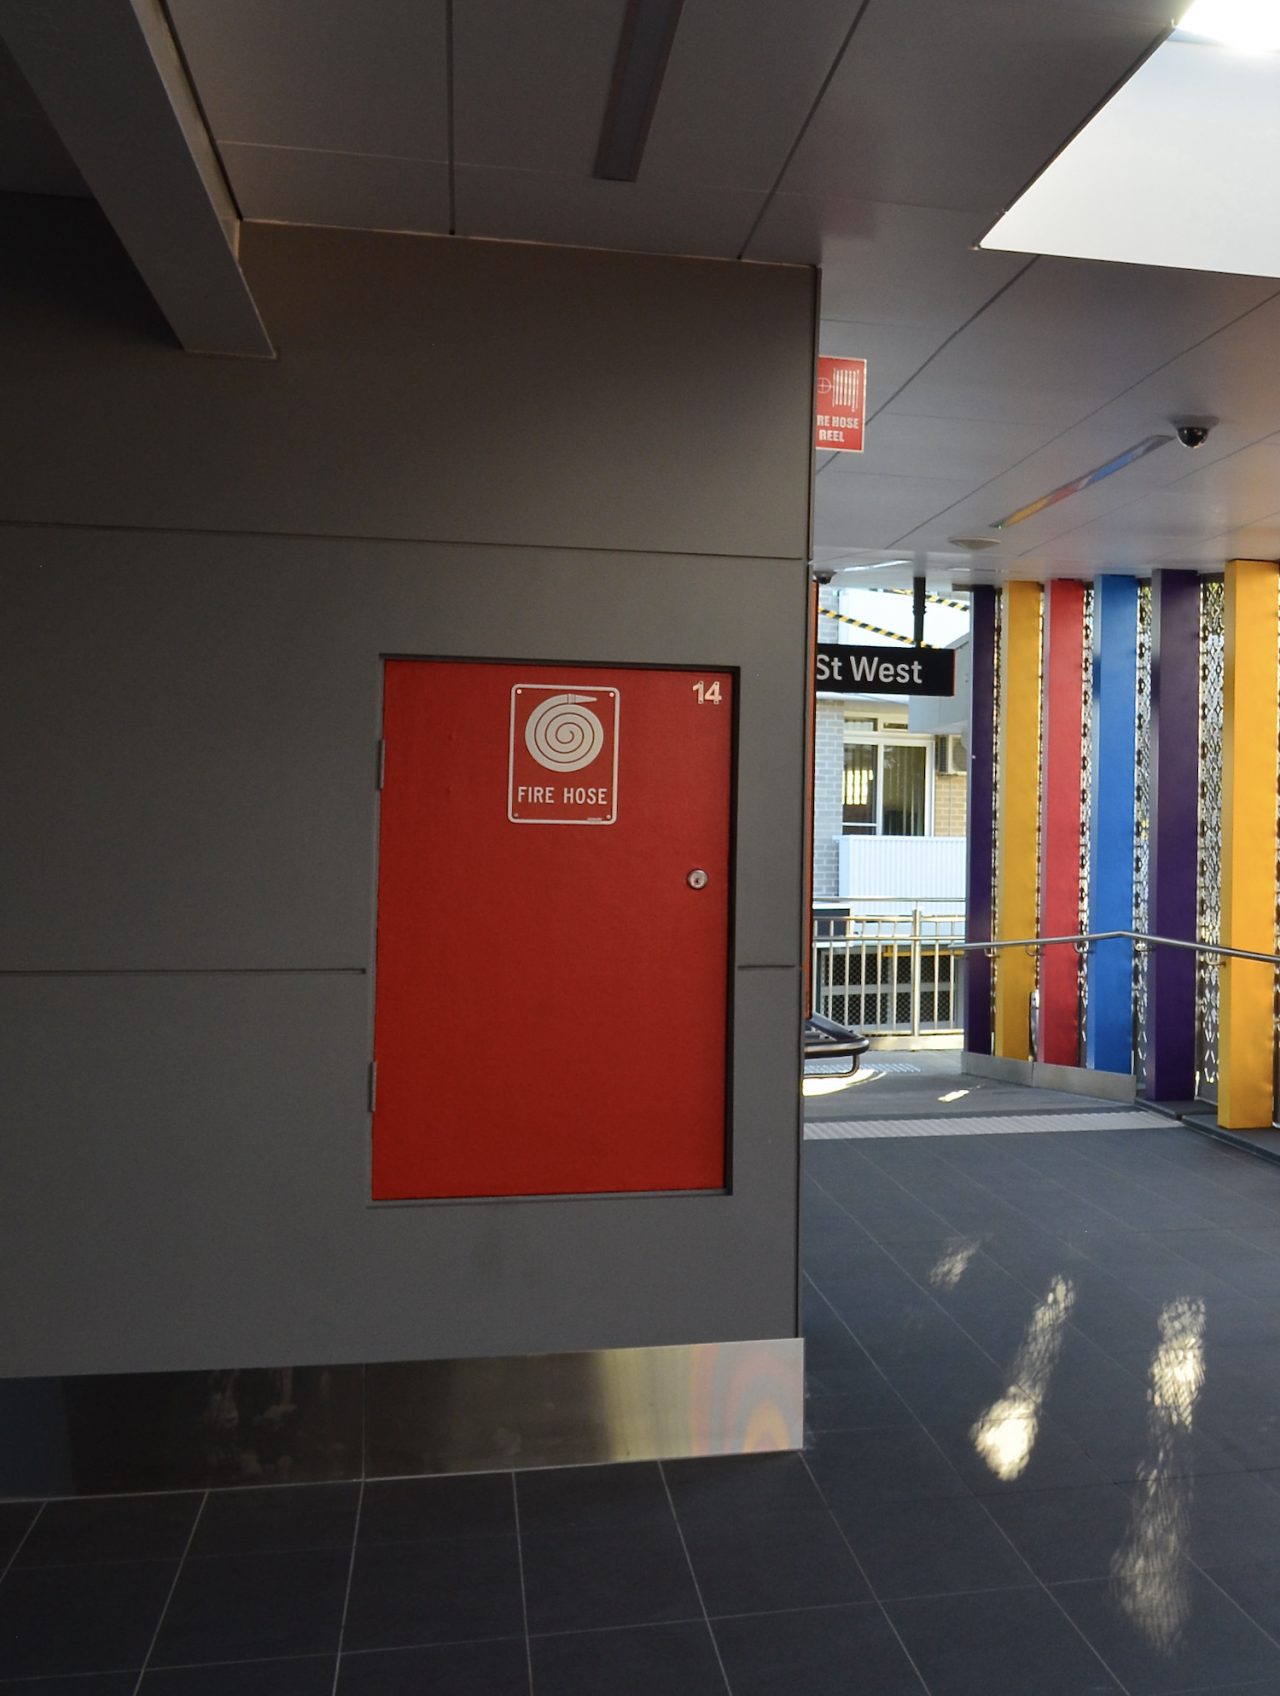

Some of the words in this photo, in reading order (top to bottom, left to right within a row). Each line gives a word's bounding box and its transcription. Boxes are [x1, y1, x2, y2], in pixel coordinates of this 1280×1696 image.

[816, 415, 830, 427] RE
[832, 416, 859, 429] HOSE
[819, 429, 845, 442] REEL
[816, 654, 842, 681] St
[850, 655, 923, 684] West
[692, 680, 722, 705] 14
[518, 786, 555, 803] FIRE
[563, 787, 608, 805] HOSE
